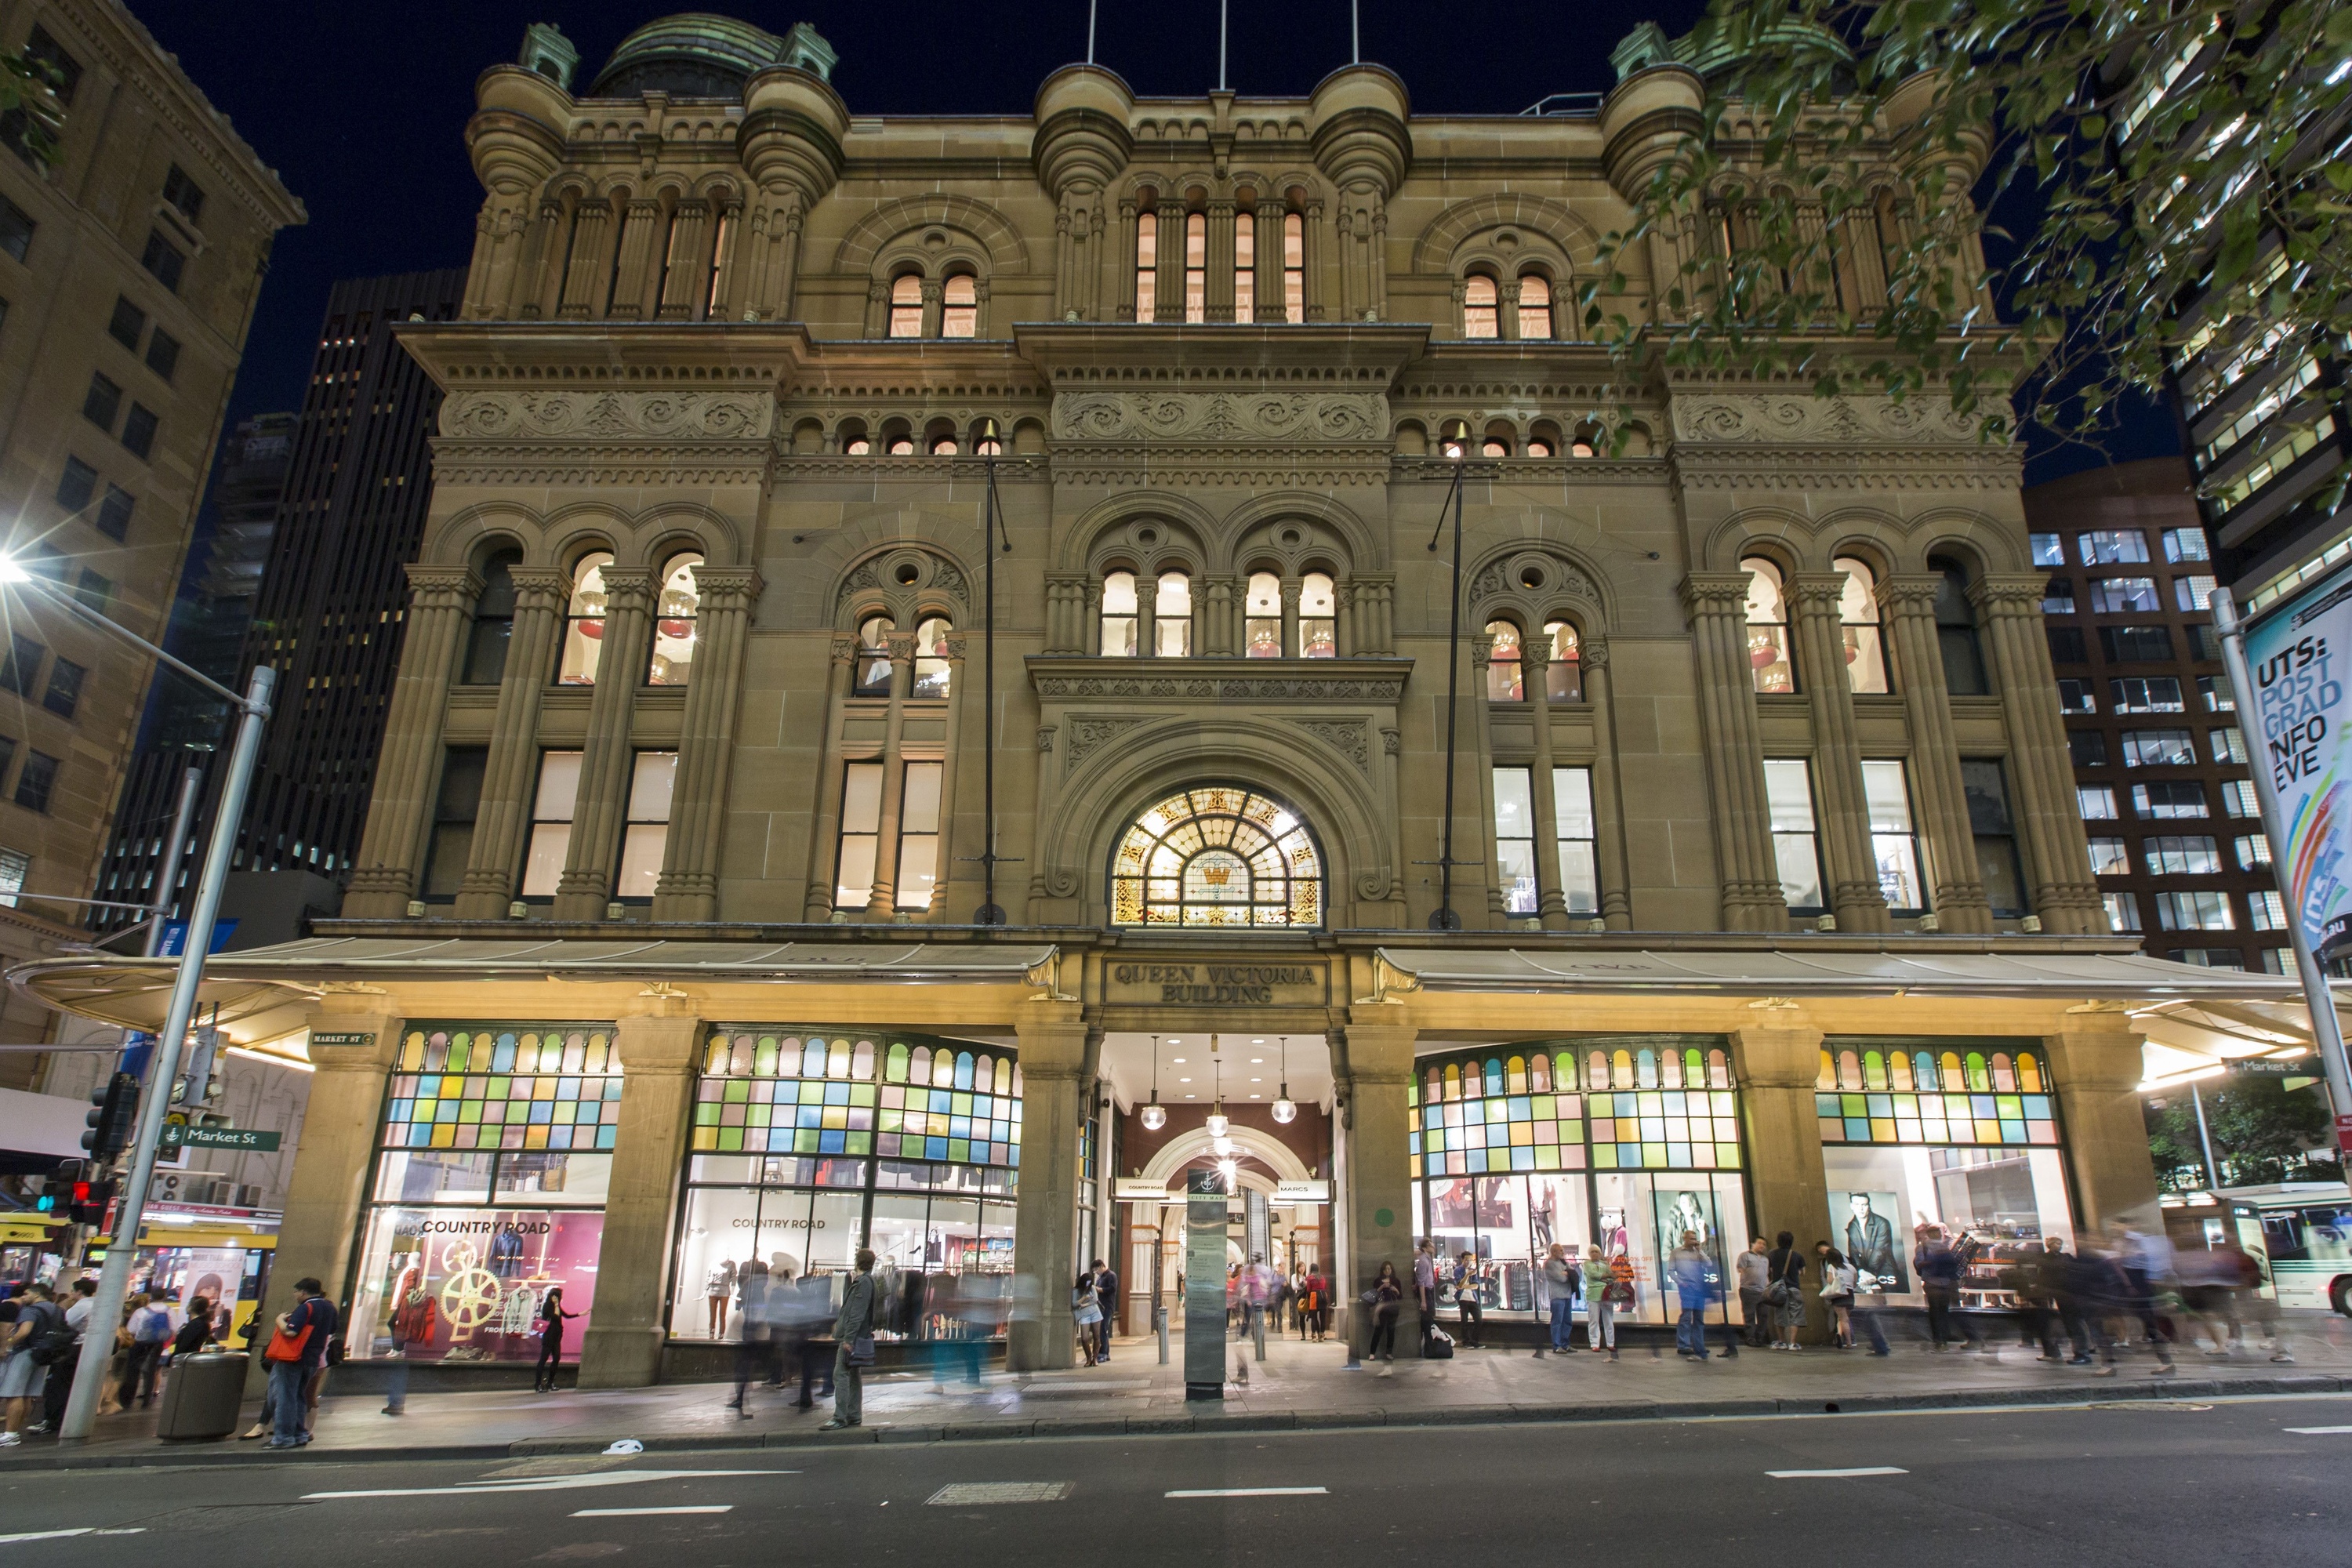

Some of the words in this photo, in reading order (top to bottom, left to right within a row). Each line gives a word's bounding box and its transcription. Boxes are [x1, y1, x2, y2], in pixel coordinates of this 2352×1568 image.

[2259, 635, 2327, 688] UTS:
[2259, 652, 2333, 717] POST
[2264, 680, 2343, 740] GRAD
[2274, 744, 2321, 794] EVE
[1114, 964, 1196, 984] QUEEN
[1207, 966, 1318, 985] VICTORIA
[1161, 984, 1272, 1004] BUILDING
[313, 1034, 347, 1043] MARKET
[2242, 1061, 2286, 1072] Market
[2288, 1061, 2301, 1072] St
[187, 1129, 239, 1144] Market
[241, 1132, 257, 1145] St
[422, 1220, 503, 1234] COUNTRY
[503, 1221, 550, 1235] ROAD
[732, 1218, 789, 1229] COUNTRY
[791, 1219, 826, 1229] ROAD
